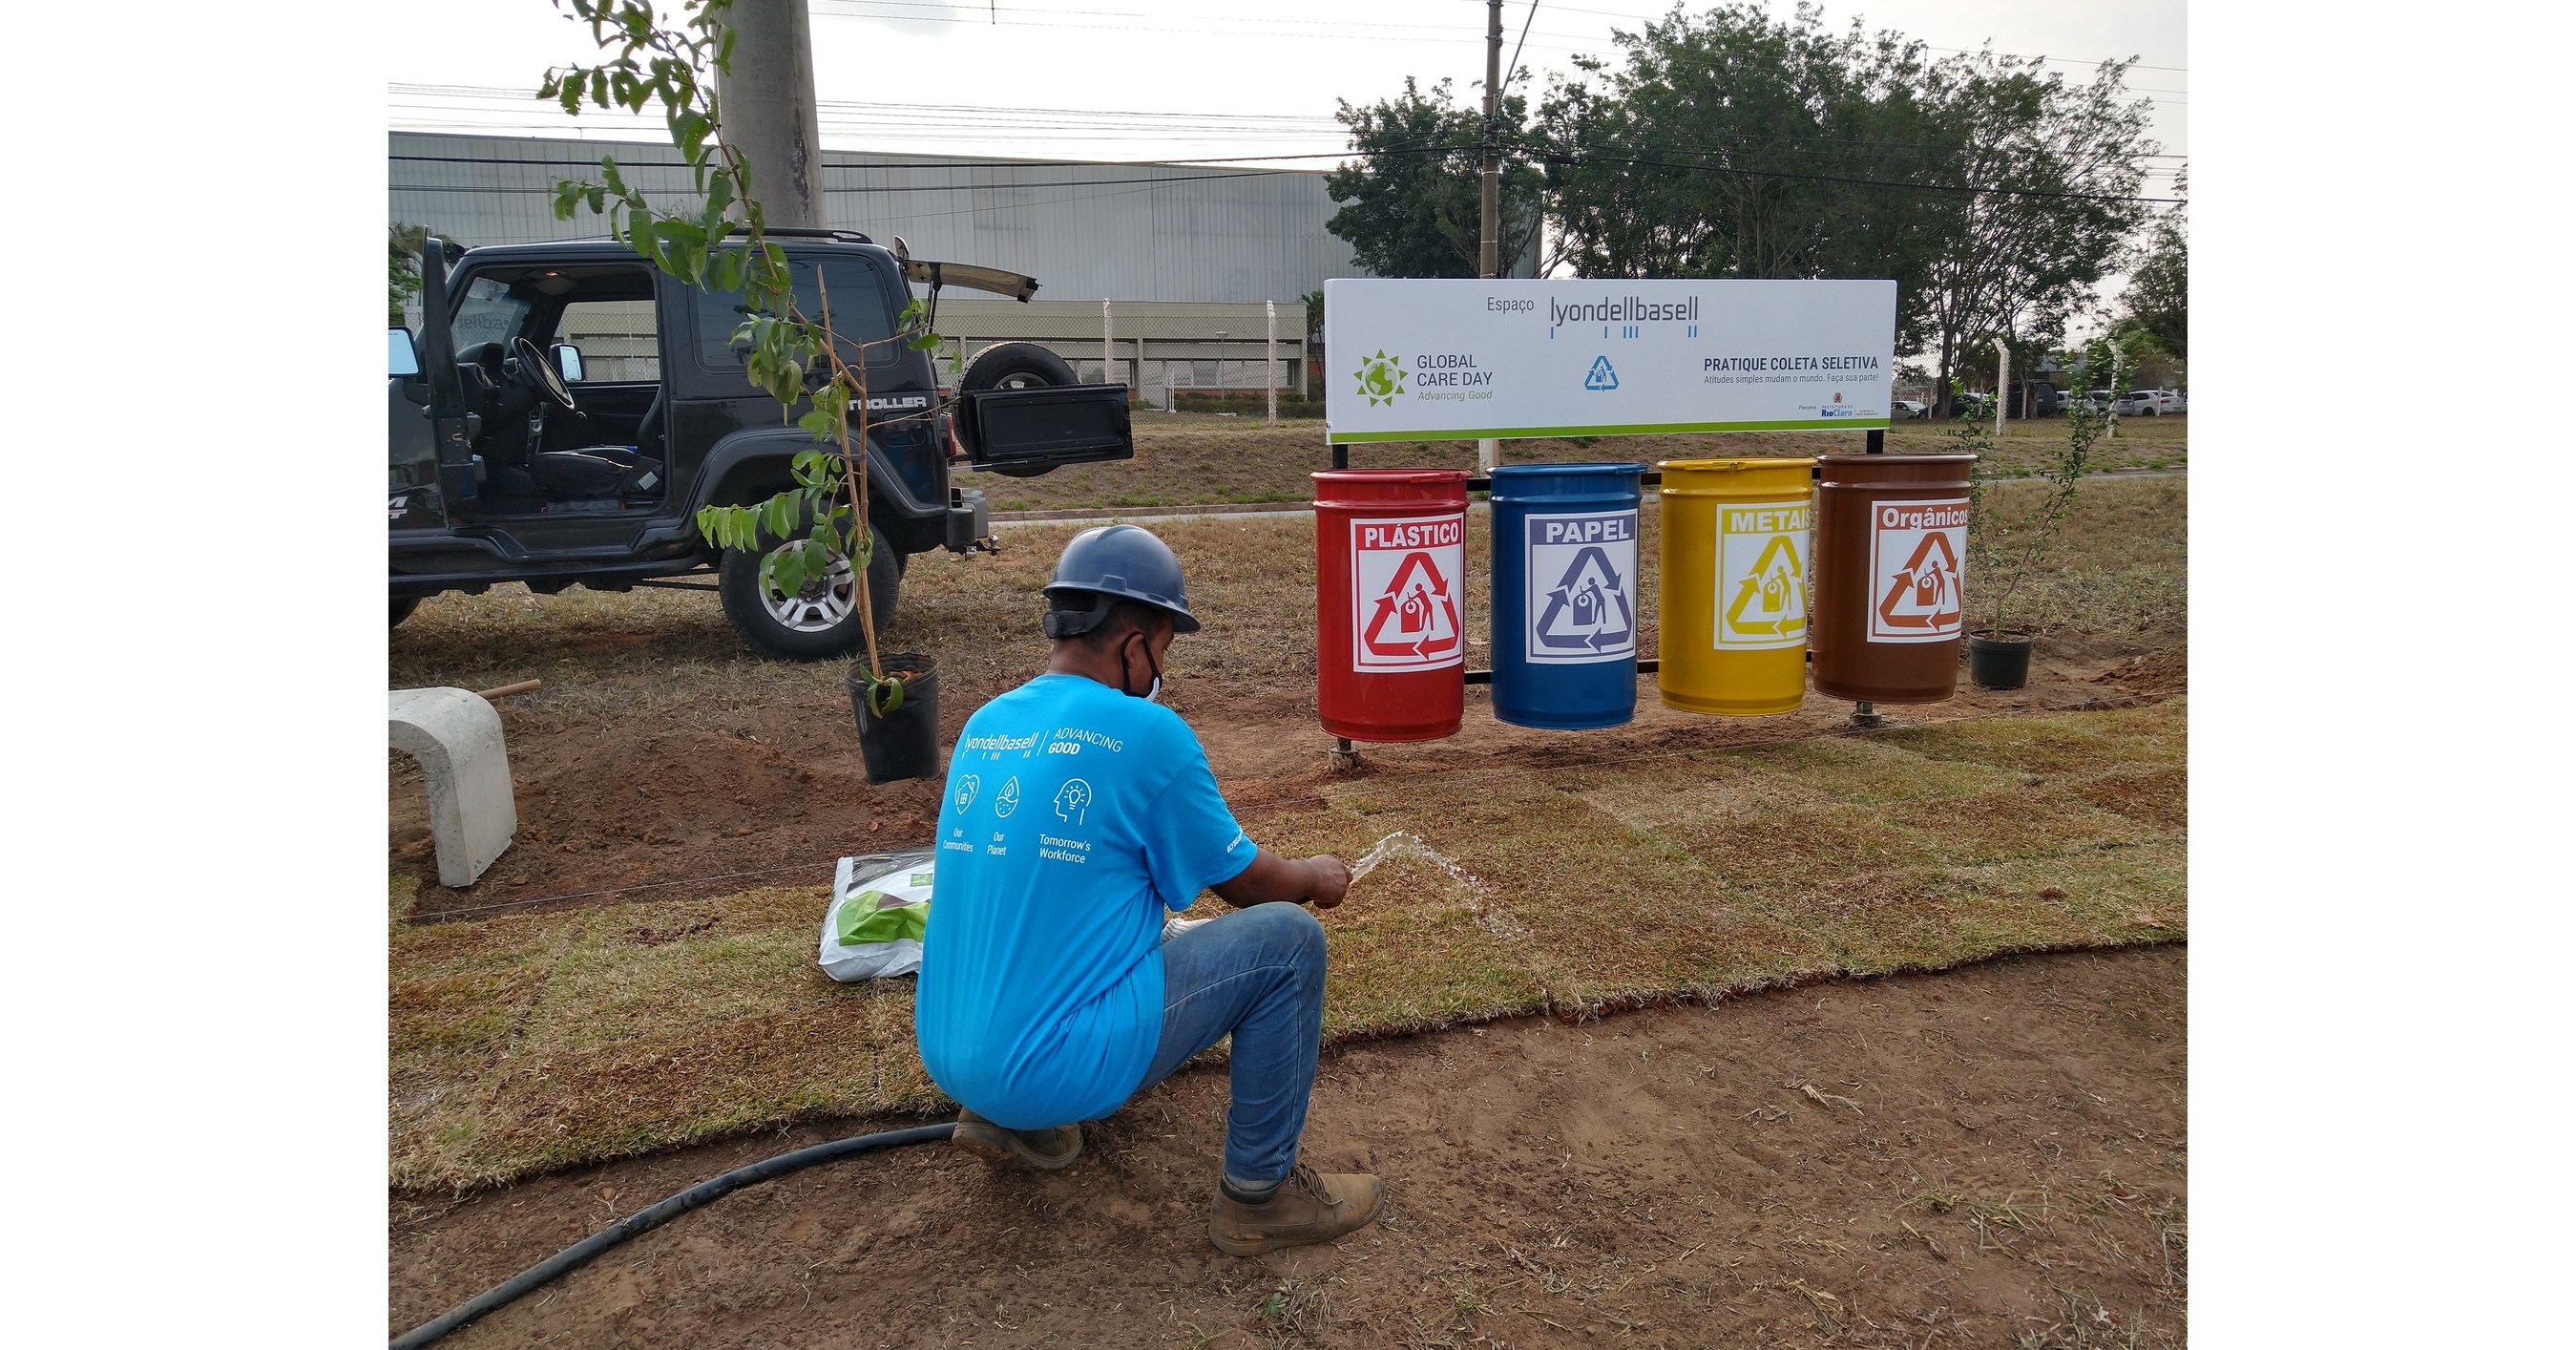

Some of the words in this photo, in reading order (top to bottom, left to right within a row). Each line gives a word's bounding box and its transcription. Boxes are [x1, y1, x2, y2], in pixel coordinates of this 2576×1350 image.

[1487, 296, 1535, 314] Espaço
[1550, 296, 1698, 327] lyondellbasell
[1417, 354, 1477, 369] GLOBAL
[1704, 358, 1767, 372] PRATIQUE
[1770, 357, 1818, 370] COLETA
[1821, 356, 1878, 369] SELETIVA
[1417, 372, 1458, 387] CARE
[1462, 371, 1493, 386] DAY
[1704, 374, 1734, 384] Atitudes
[1736, 374, 1764, 385] simples
[1765, 374, 1791, 383] mudam
[1799, 373, 1825, 383] mundo.
[1827, 373, 1844, 384] Faça
[1858, 373, 1879, 384] parte!
[1417, 390, 1466, 402] Advancing
[1468, 390, 1493, 400] Good
[1364, 521, 1459, 548] PLÁSTICO
[1546, 518, 1629, 543] PAPEL
[964, 731, 1040, 752] lyondellbasell
[1053, 727, 1124, 752] ADVANCING
[1048, 741, 1081, 755] GOOD
[953, 827, 964, 838] Our
[993, 831, 1005, 842] Our
[943, 839, 974, 853] Communities
[987, 844, 1007, 856] Planet
[1039, 833, 1092, 852] Tomorrow's
[1039, 847, 1086, 864] Workforce
